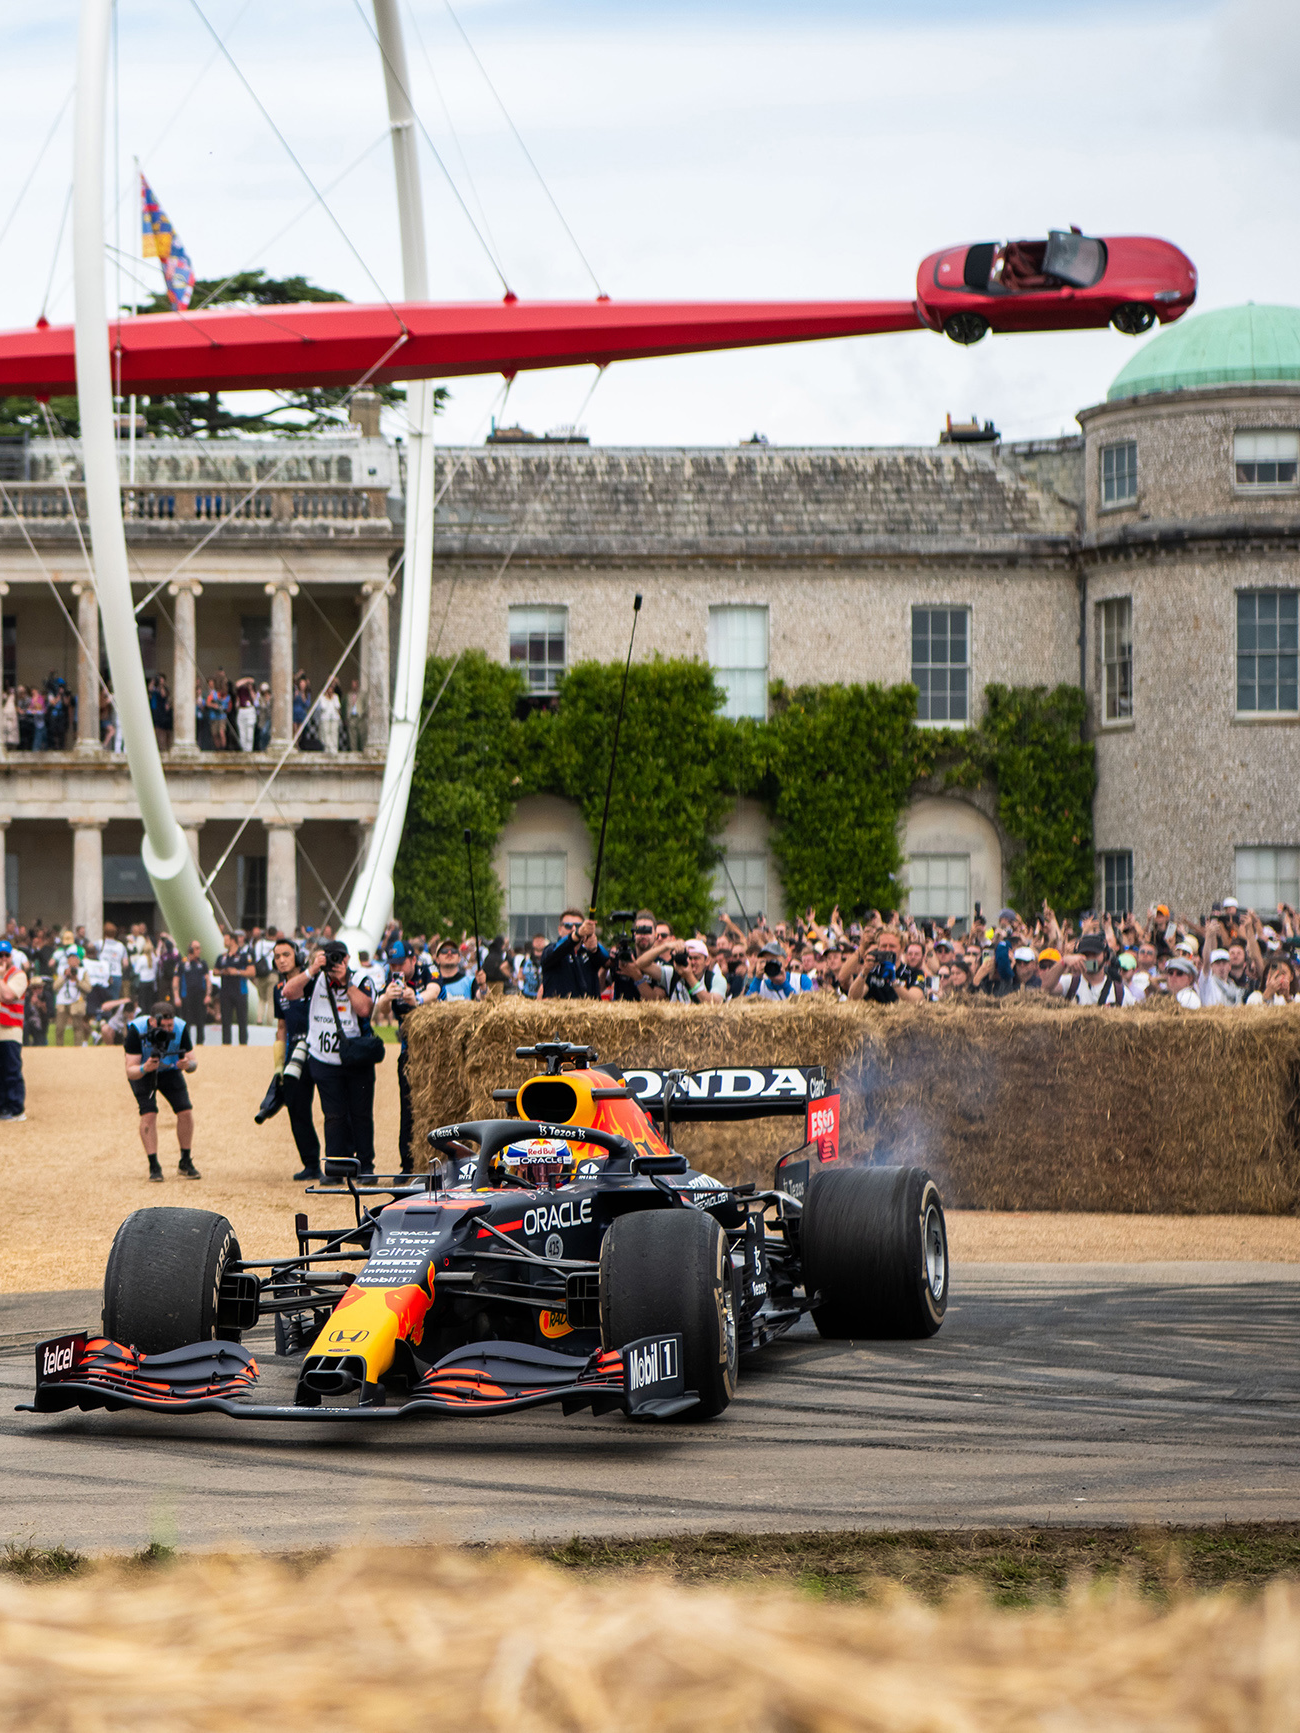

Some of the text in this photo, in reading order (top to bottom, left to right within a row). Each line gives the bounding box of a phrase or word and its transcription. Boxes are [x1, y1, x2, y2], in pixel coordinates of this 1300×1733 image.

[318, 1030, 340, 1053] 162
[549, 1126, 576, 1138] Tezos
[520, 1156, 563, 1165] ORACLE
[523, 1197, 593, 1236] ORACLE
[376, 1247, 429, 1257] citrix
[42, 1340, 75, 1376] telcel
[629, 1342, 659, 1391] Mobil
